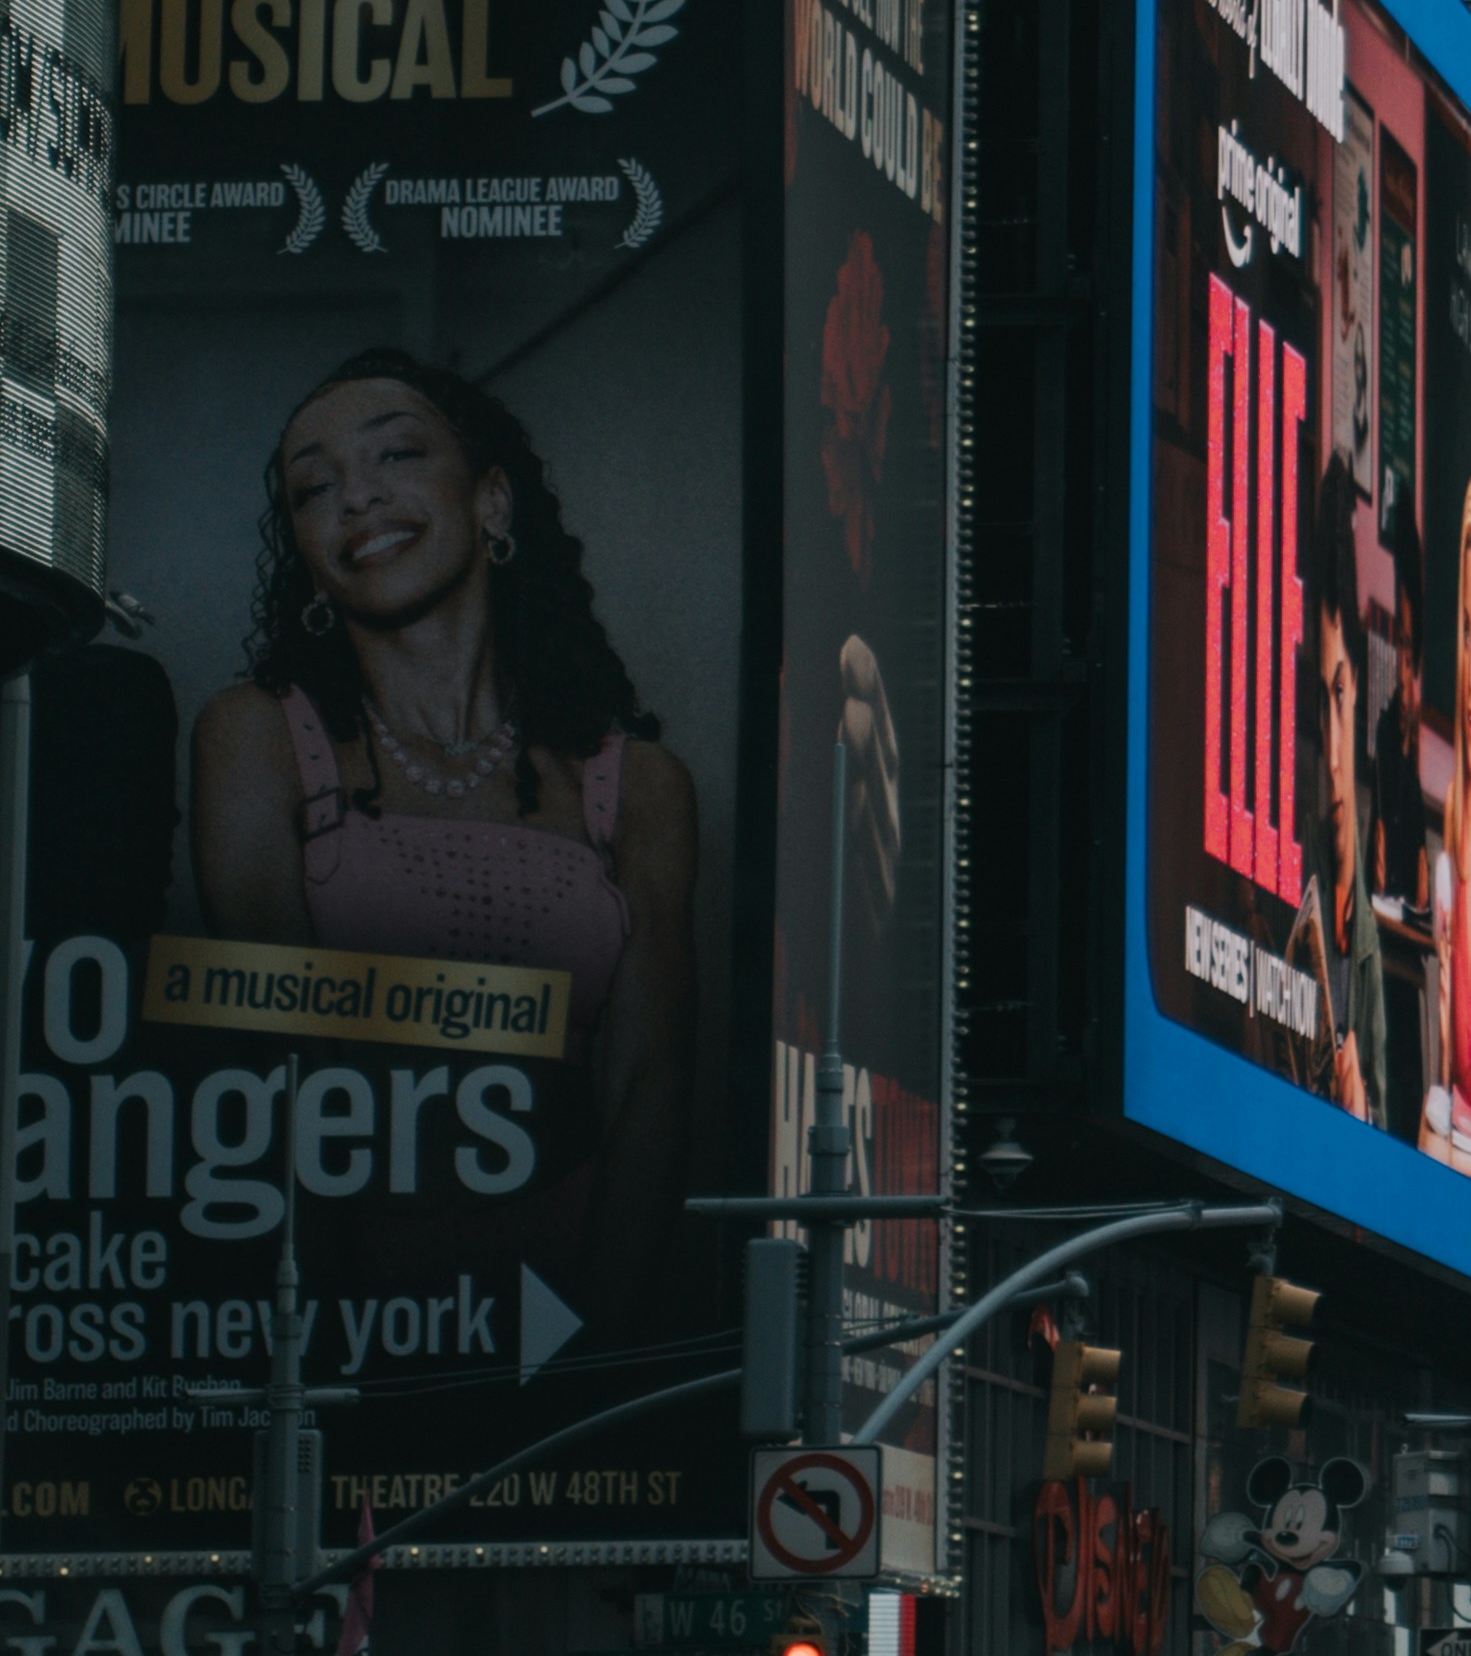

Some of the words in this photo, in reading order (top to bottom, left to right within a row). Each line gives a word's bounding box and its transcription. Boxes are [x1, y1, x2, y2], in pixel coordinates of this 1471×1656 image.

[860, 46, 919, 202] COULD
[920, 106, 944, 227] BE
[136, 182, 208, 210] CIRCLE
[209, 181, 285, 208] AWARD
[384, 178, 463, 206] DRAMA
[465, 177, 543, 204] LEAGUE
[544, 175, 620, 202] AWARD
[1217, 117, 1256, 214] prime
[1254, 154, 1302, 260] original
[440, 204, 563, 241] NOMINEE
[1203, 270, 1308, 913] ELLE
[164, 963, 190, 1002] a
[202, 961, 378, 1020] musical
[384, 972, 551, 1040] original
[9, 1209, 169, 1291] cake
[338, 1274, 497, 1377] york
[43, 1378, 99, 1402] Barne
[101, 1376, 139, 1401] and
[142, 1375, 168, 1400] Kit
[23, 1409, 169, 1436] Choreographed
[172, 1409, 196, 1435] by
[200, 1405, 235, 1429] Tim
[529, 1472, 558, 1506] W
[565, 1471, 639, 1506] 48TH
[647, 1470, 682, 1506] ST
[670, 1600, 695, 1637] W
[709, 1600, 748, 1638] 46
